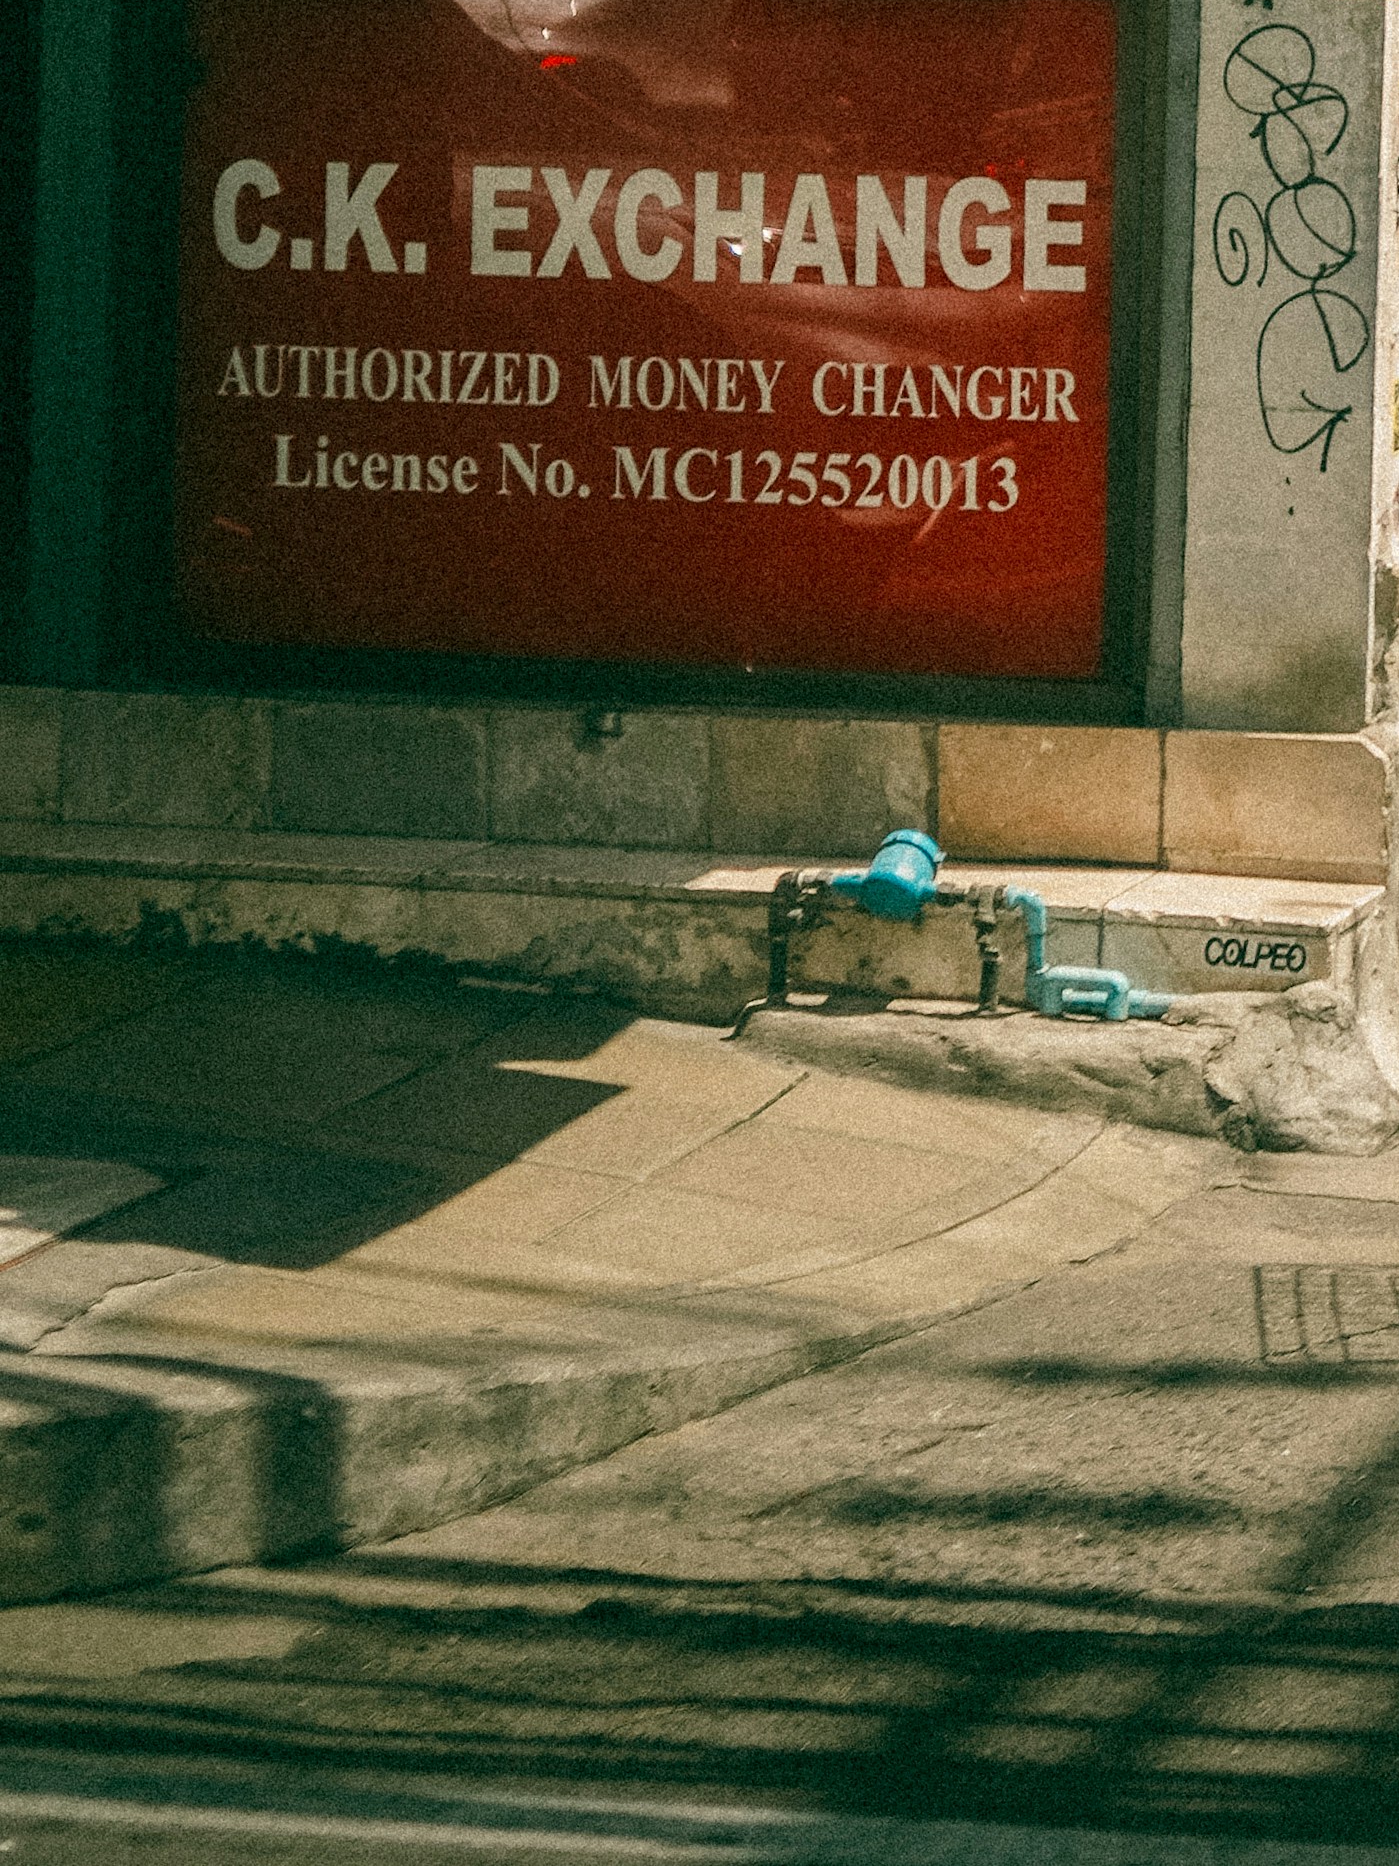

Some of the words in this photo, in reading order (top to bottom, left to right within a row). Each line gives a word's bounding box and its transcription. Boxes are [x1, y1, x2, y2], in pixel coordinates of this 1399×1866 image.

[212, 158, 428, 275] C.K.
[469, 164, 1087, 294] EXCHANGE
[217, 343, 561, 409] AUTHORIZED
[588, 353, 786, 415] MONEY
[811, 360, 1080, 424] CHANGER
[273, 434, 479, 495] License
[497, 442, 592, 501] No.
[612, 445, 1021, 514] MC125520013
